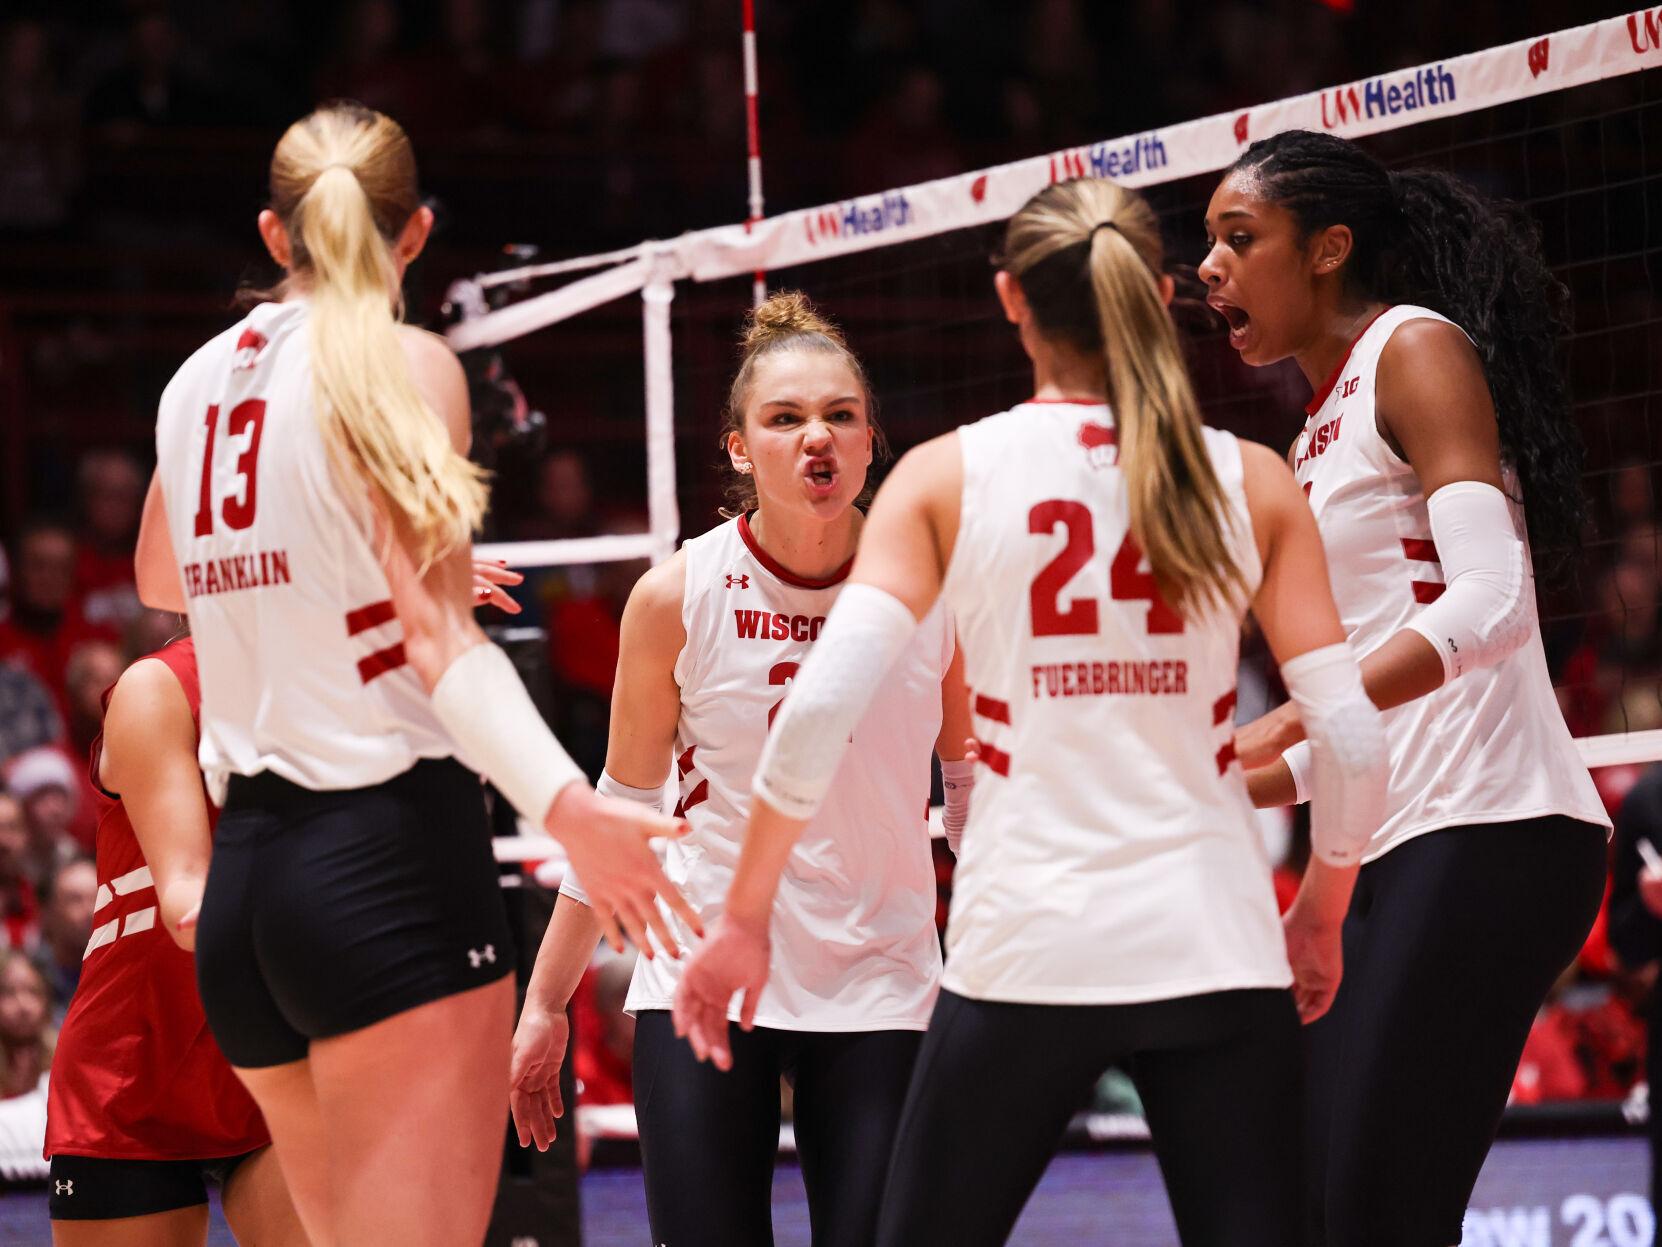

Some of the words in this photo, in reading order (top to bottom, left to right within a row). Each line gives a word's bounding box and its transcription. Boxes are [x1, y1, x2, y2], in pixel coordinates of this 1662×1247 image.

[195, 398, 266, 537] 13
[1029, 500, 1186, 636] 24
[1032, 660, 1188, 698] FUERBRINGER
